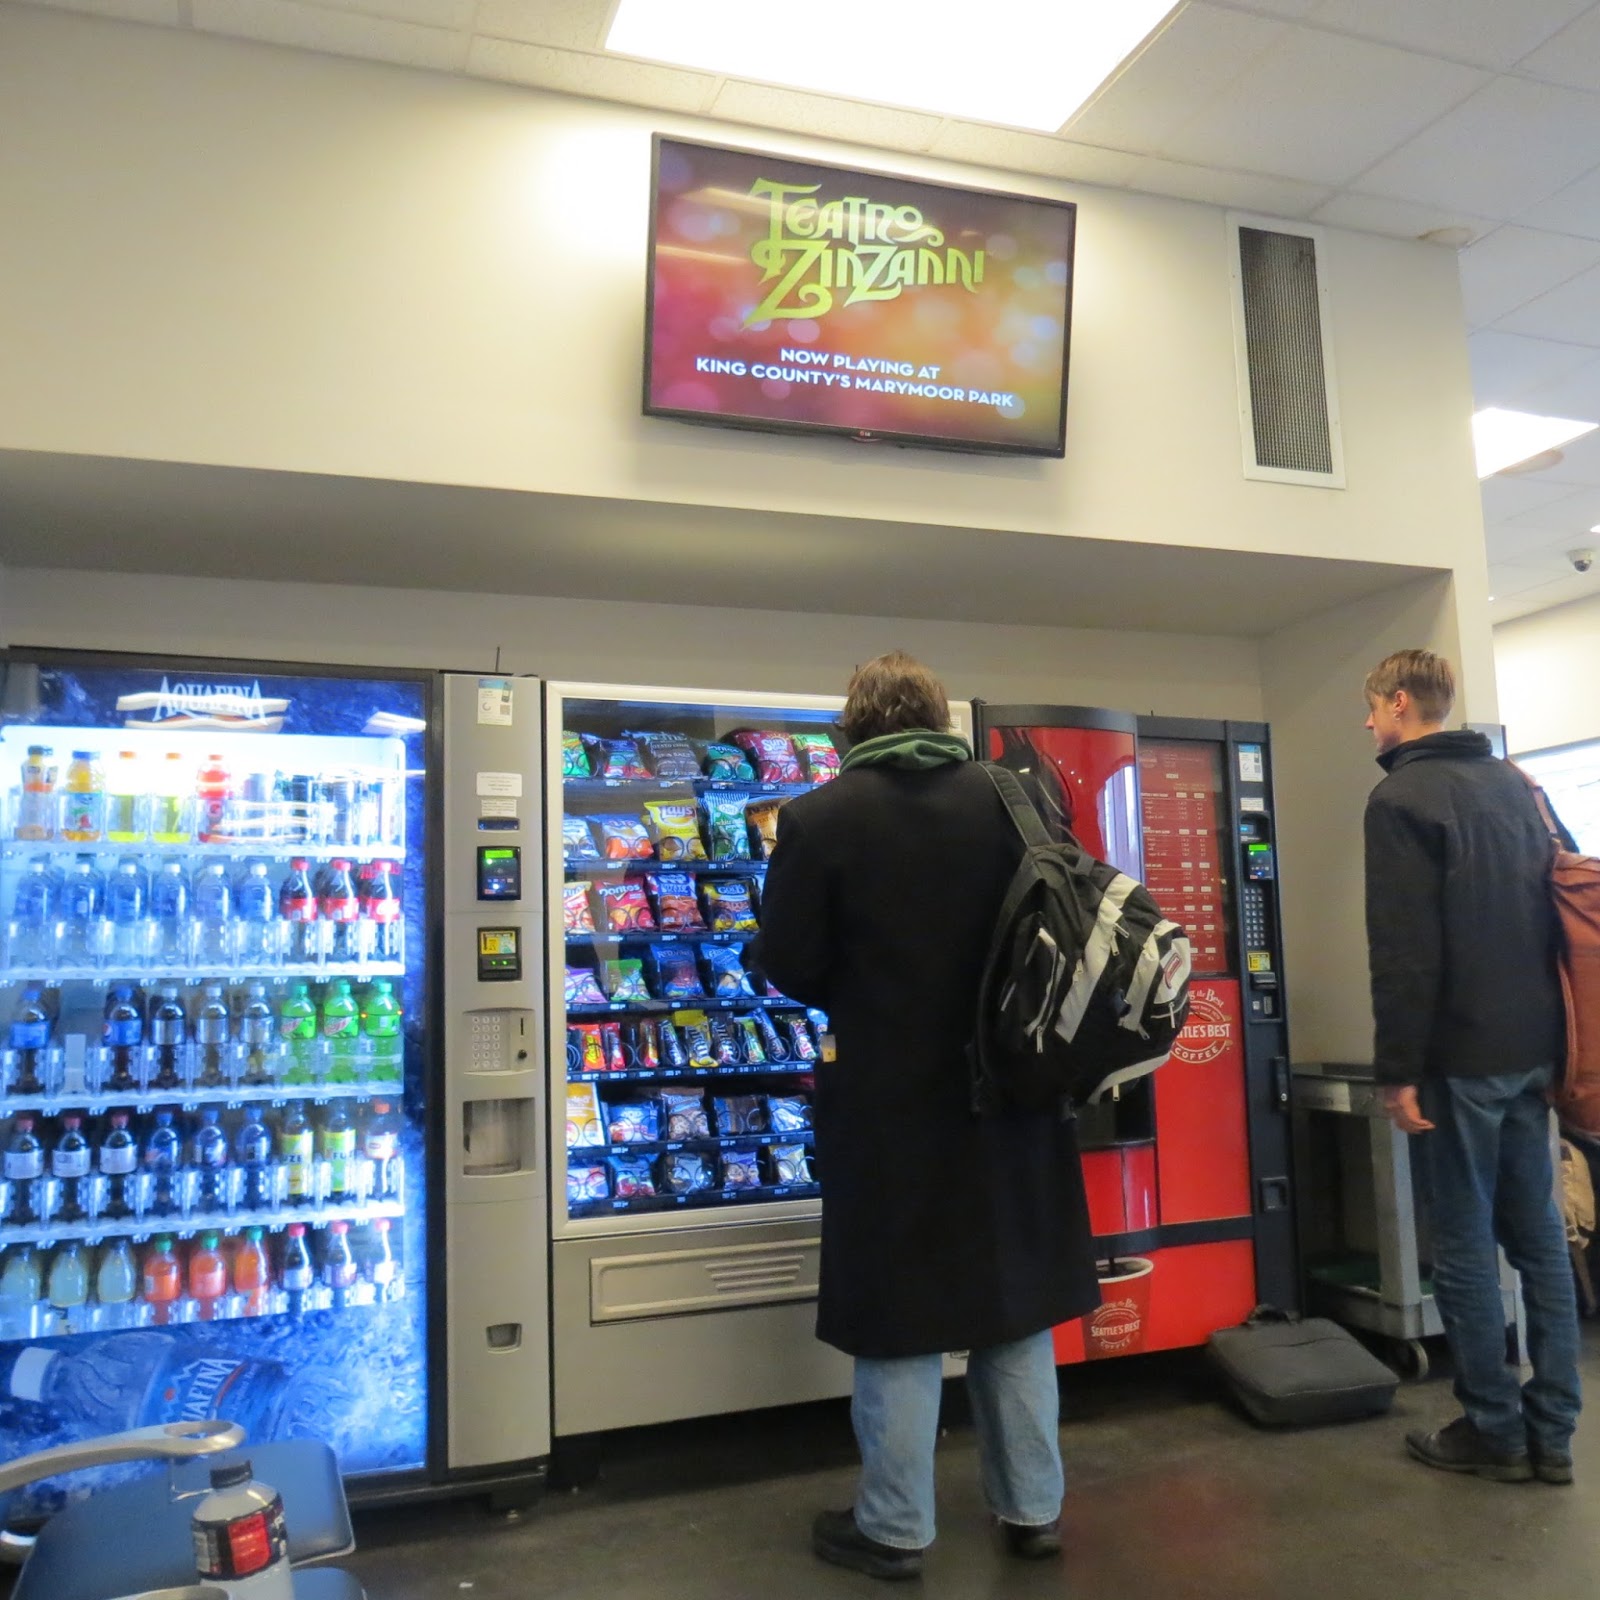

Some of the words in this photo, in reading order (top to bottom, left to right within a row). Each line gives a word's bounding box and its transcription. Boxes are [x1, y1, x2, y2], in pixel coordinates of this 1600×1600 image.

[780, 348, 829, 366] NOW
[833, 355, 914, 377] PLAYING
[918, 366, 940, 380] AT
[696, 357, 747, 376] KING
[751, 364, 851, 388] COUNTY'S
[855, 377, 965, 402] MARYMOOR
[968, 390, 1014, 407] PARK
[1207, 1023, 1231, 1038] BEST
[1174, 1046, 1219, 1060] COFFEE
[1091, 1325, 1123, 1336] SEATTLE'S
